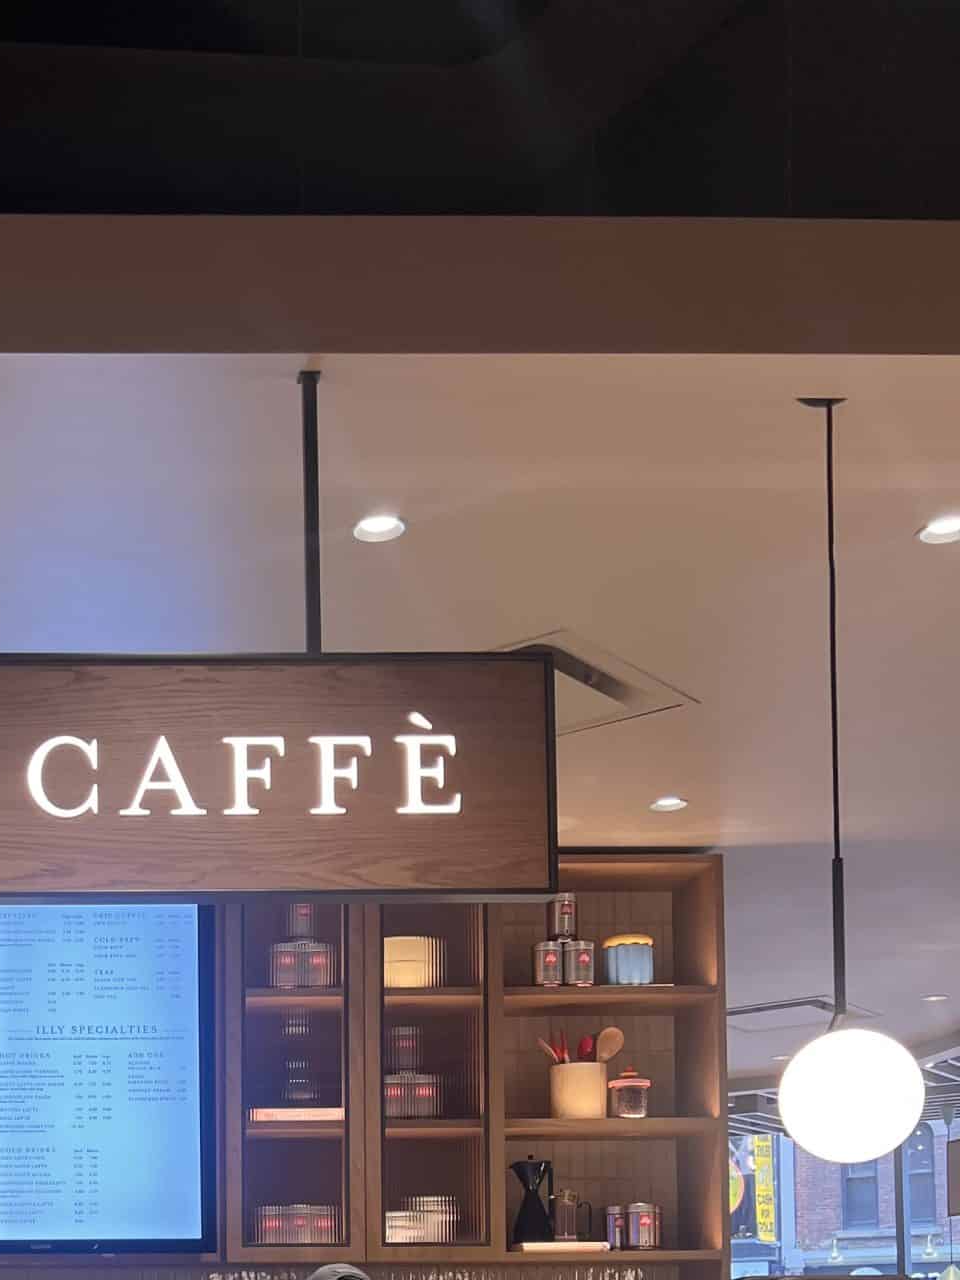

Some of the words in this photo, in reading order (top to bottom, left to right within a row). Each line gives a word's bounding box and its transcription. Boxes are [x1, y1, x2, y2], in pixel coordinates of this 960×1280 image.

[25, 711, 463, 819] CAFFÈ
[36, 1025, 65, 1035] ILLY
[71, 1025, 158, 1034] SPECIALTIES
